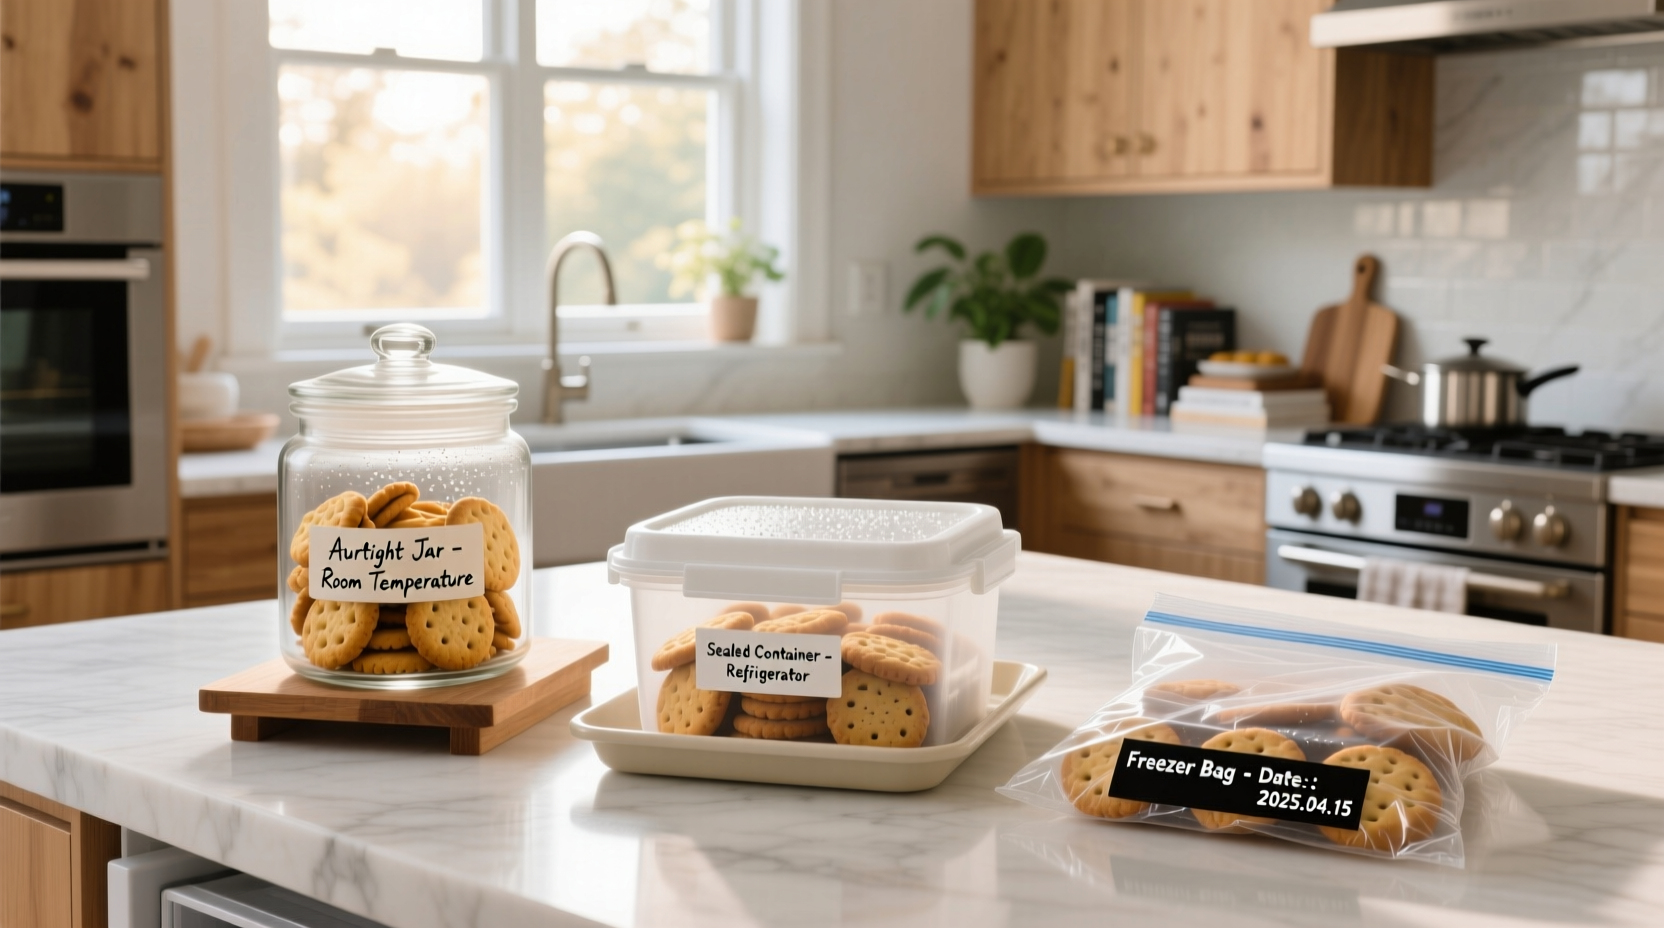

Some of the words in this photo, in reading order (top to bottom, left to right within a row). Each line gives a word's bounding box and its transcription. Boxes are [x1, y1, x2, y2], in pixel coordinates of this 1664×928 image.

[412, 537, 444, 561] Jar
[321, 567, 362, 589] Room
[369, 570, 474, 598] Temperature
[707, 642, 750, 658] Sealed
[754, 644, 821, 662] Container
[726, 663, 810, 684] Refrigerator
[1126, 750, 1196, 776] Freezer
[1199, 759, 1236, 785] Bag
[1257, 790, 1352, 817] 2025.04.15
